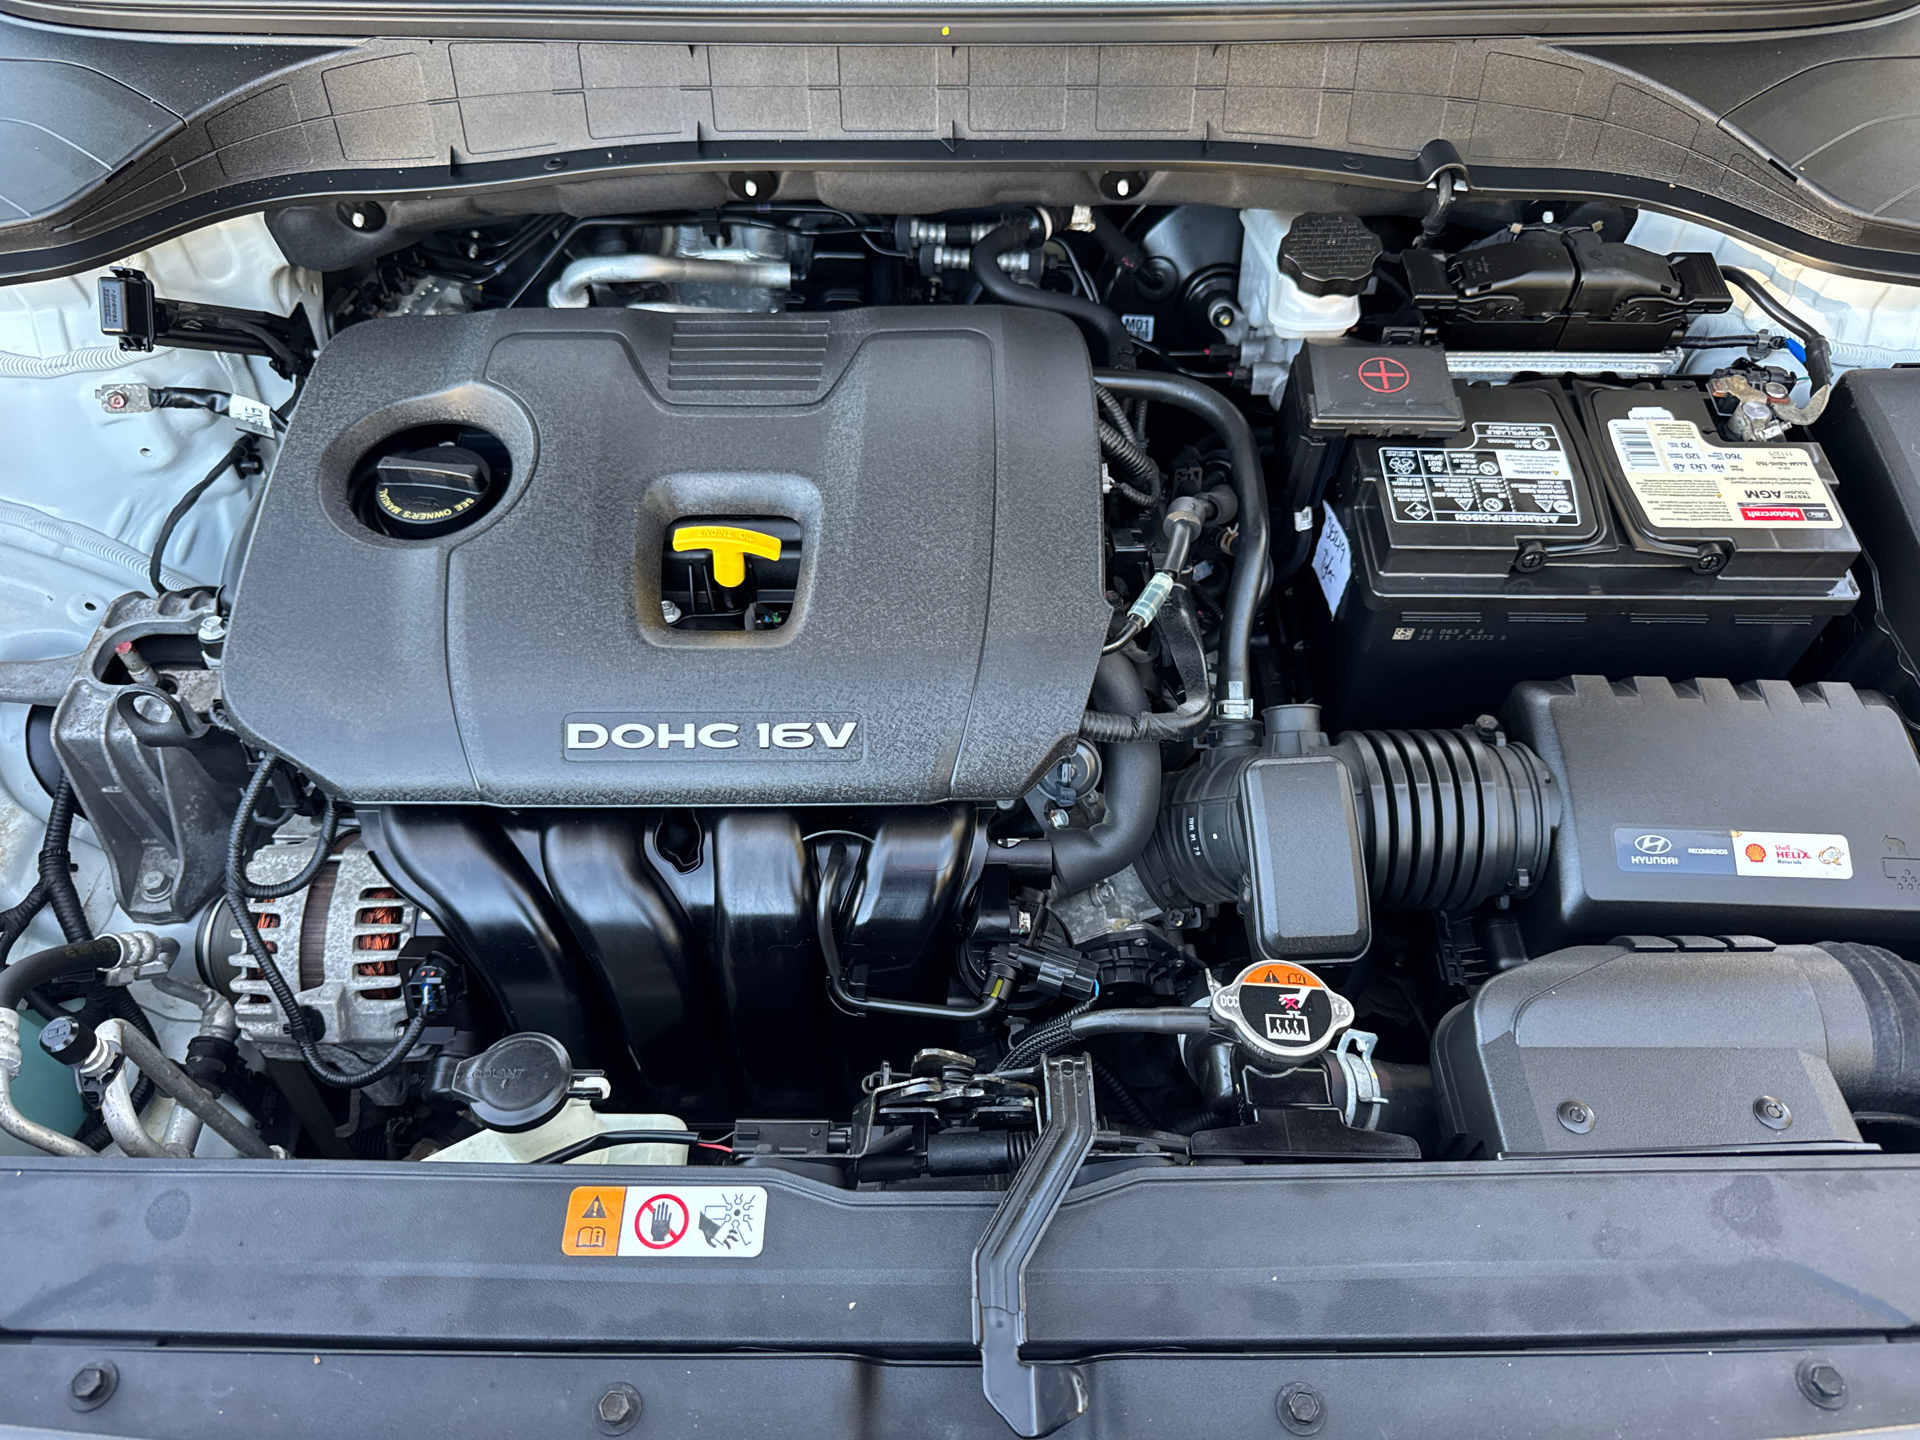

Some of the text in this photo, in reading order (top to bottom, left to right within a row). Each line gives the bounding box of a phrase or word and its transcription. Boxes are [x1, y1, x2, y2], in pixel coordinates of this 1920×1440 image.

[1744, 490, 1781, 498] AGM
[378, 488, 475, 520] SEE OWNER'S MANUAL
[1455, 514, 1550, 522] DANGER/POISON
[697, 529, 755, 542] ENGINE OIL
[567, 722, 858, 750] DOHC 16V
[1631, 847, 1729, 866] HYUNDAI RECOMMENDS
[1776, 850, 1812, 860] HELIX
[1334, 1004, 1349, 1016] 1.1
[467, 1068, 526, 1079] COOLANT
